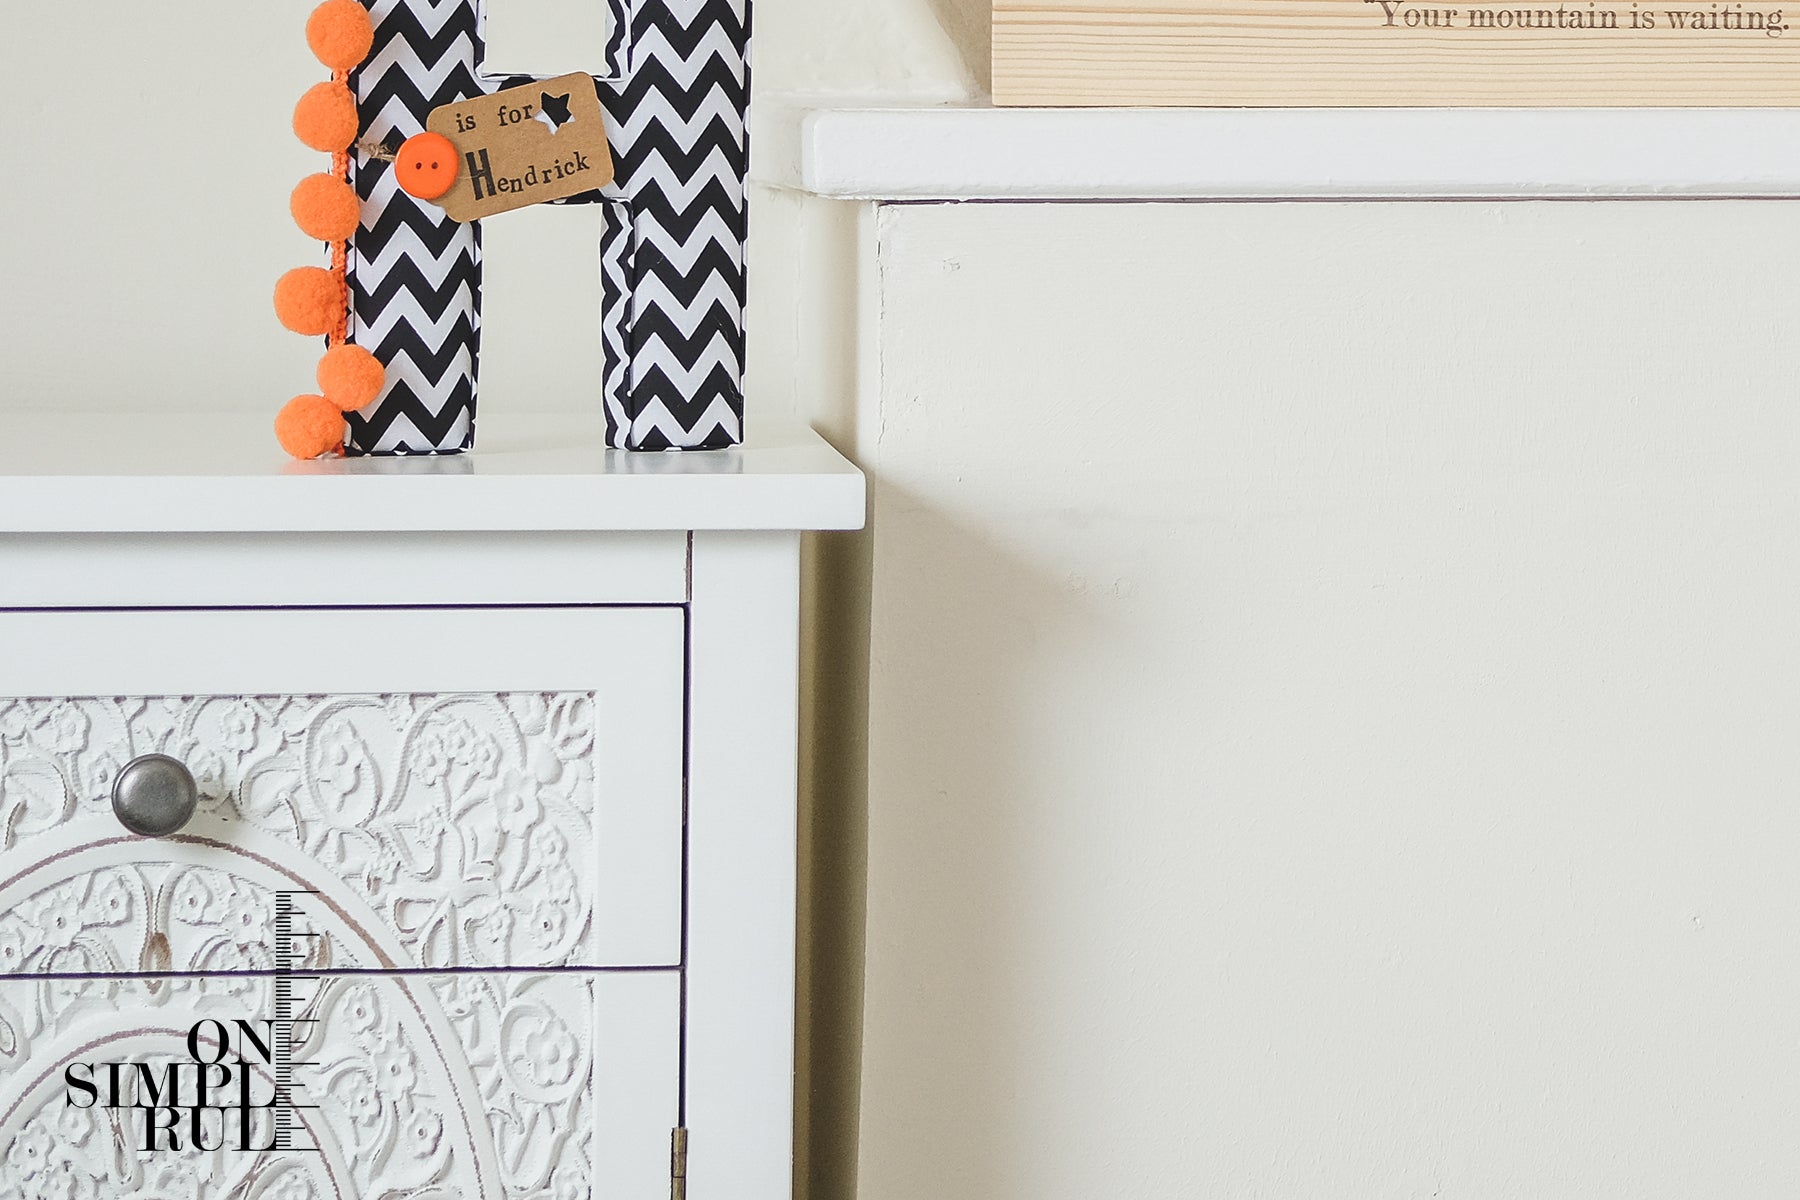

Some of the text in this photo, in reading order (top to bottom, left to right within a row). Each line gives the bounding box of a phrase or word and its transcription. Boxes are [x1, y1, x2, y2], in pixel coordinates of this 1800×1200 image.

[1467, 1, 1620, 30] mountain
[1628, 1, 1656, 30] is
[1664, 2, 1791, 39] waiting.
[456, 103, 534, 133] is for
[465, 148, 591, 201] Hendrick
